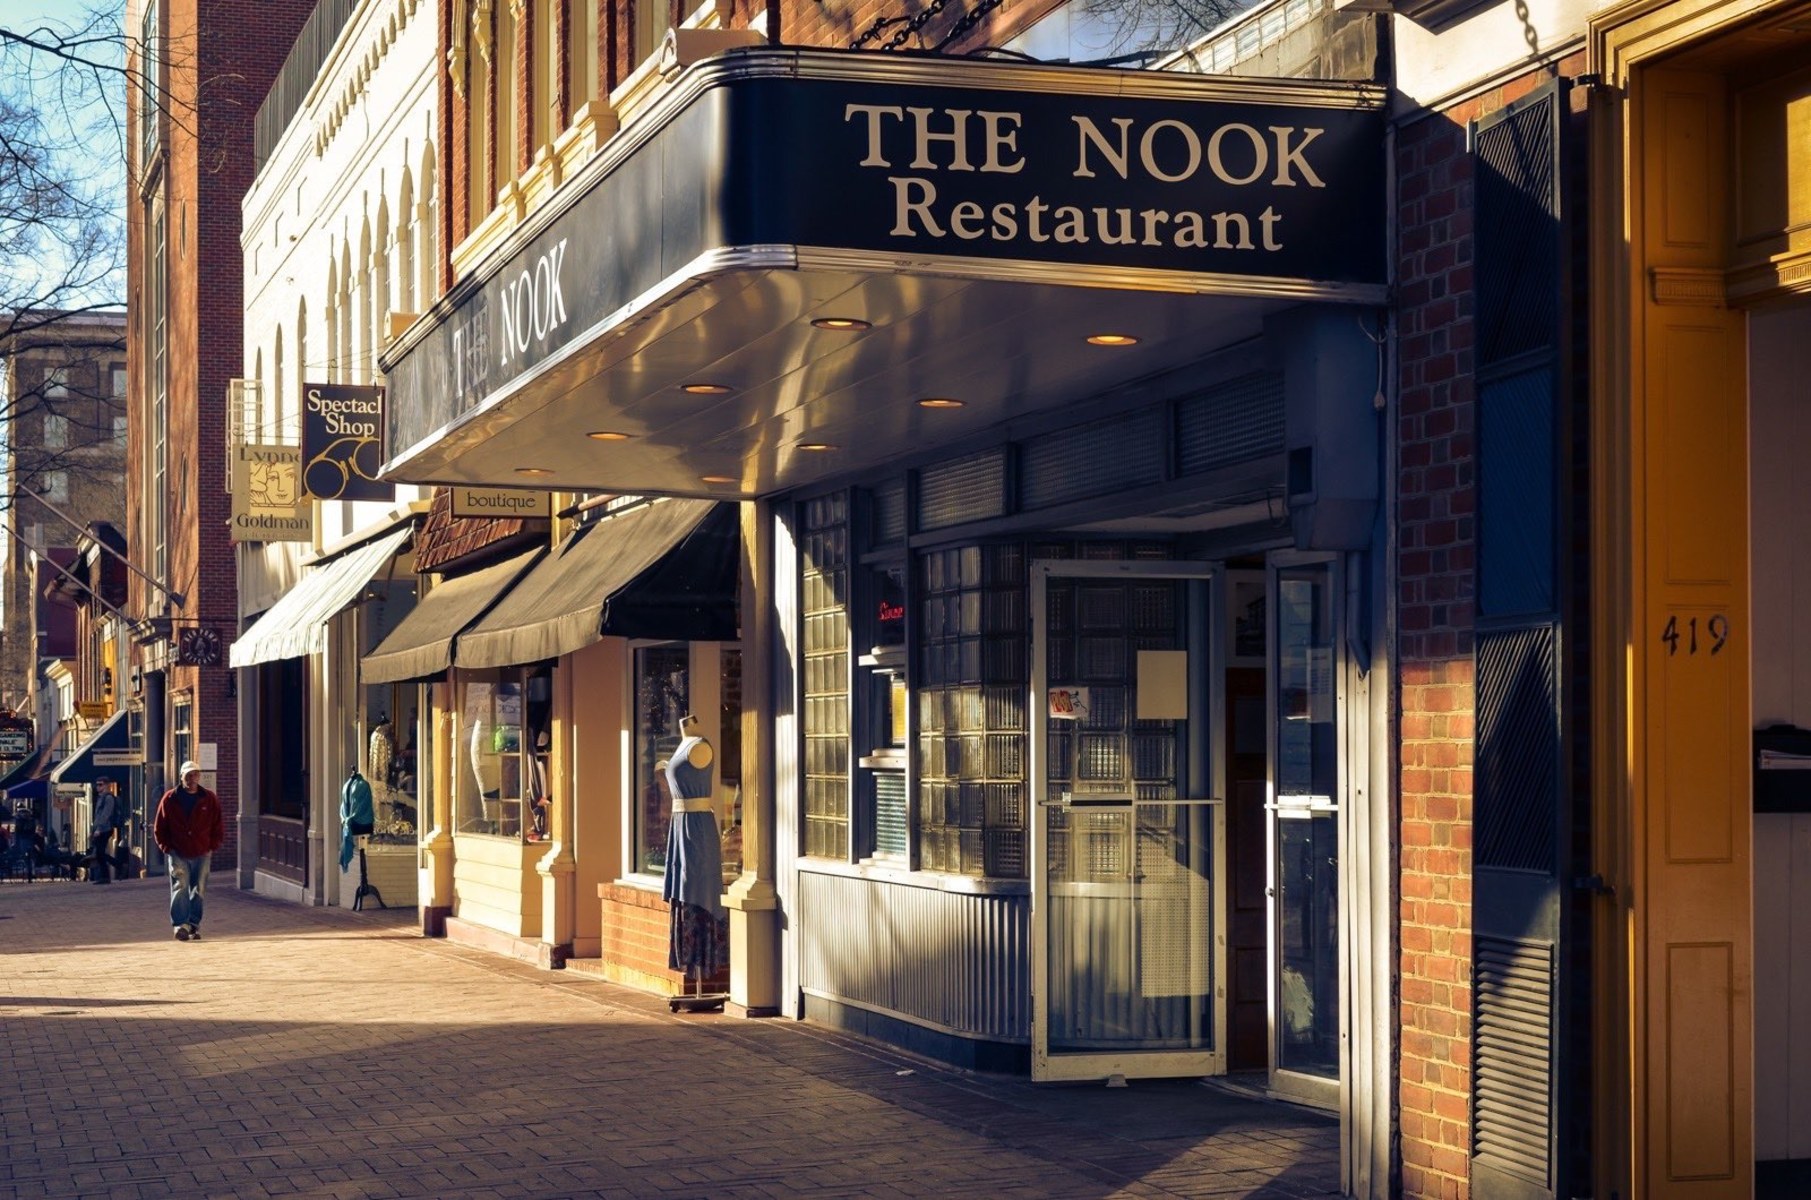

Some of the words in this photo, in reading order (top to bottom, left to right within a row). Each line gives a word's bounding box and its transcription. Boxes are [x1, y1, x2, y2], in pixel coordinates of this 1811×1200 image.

[844, 103, 1027, 174] THE
[1071, 114, 1327, 188] NOOK
[887, 176, 1284, 252] Restaurant
[453, 304, 490, 398] THE
[501, 238, 568, 367] NOOK
[325, 413, 375, 438] Shop
[236, 513, 309, 530] Goldman
[467, 492, 536, 513] boutique
[1661, 614, 1729, 657] 419
